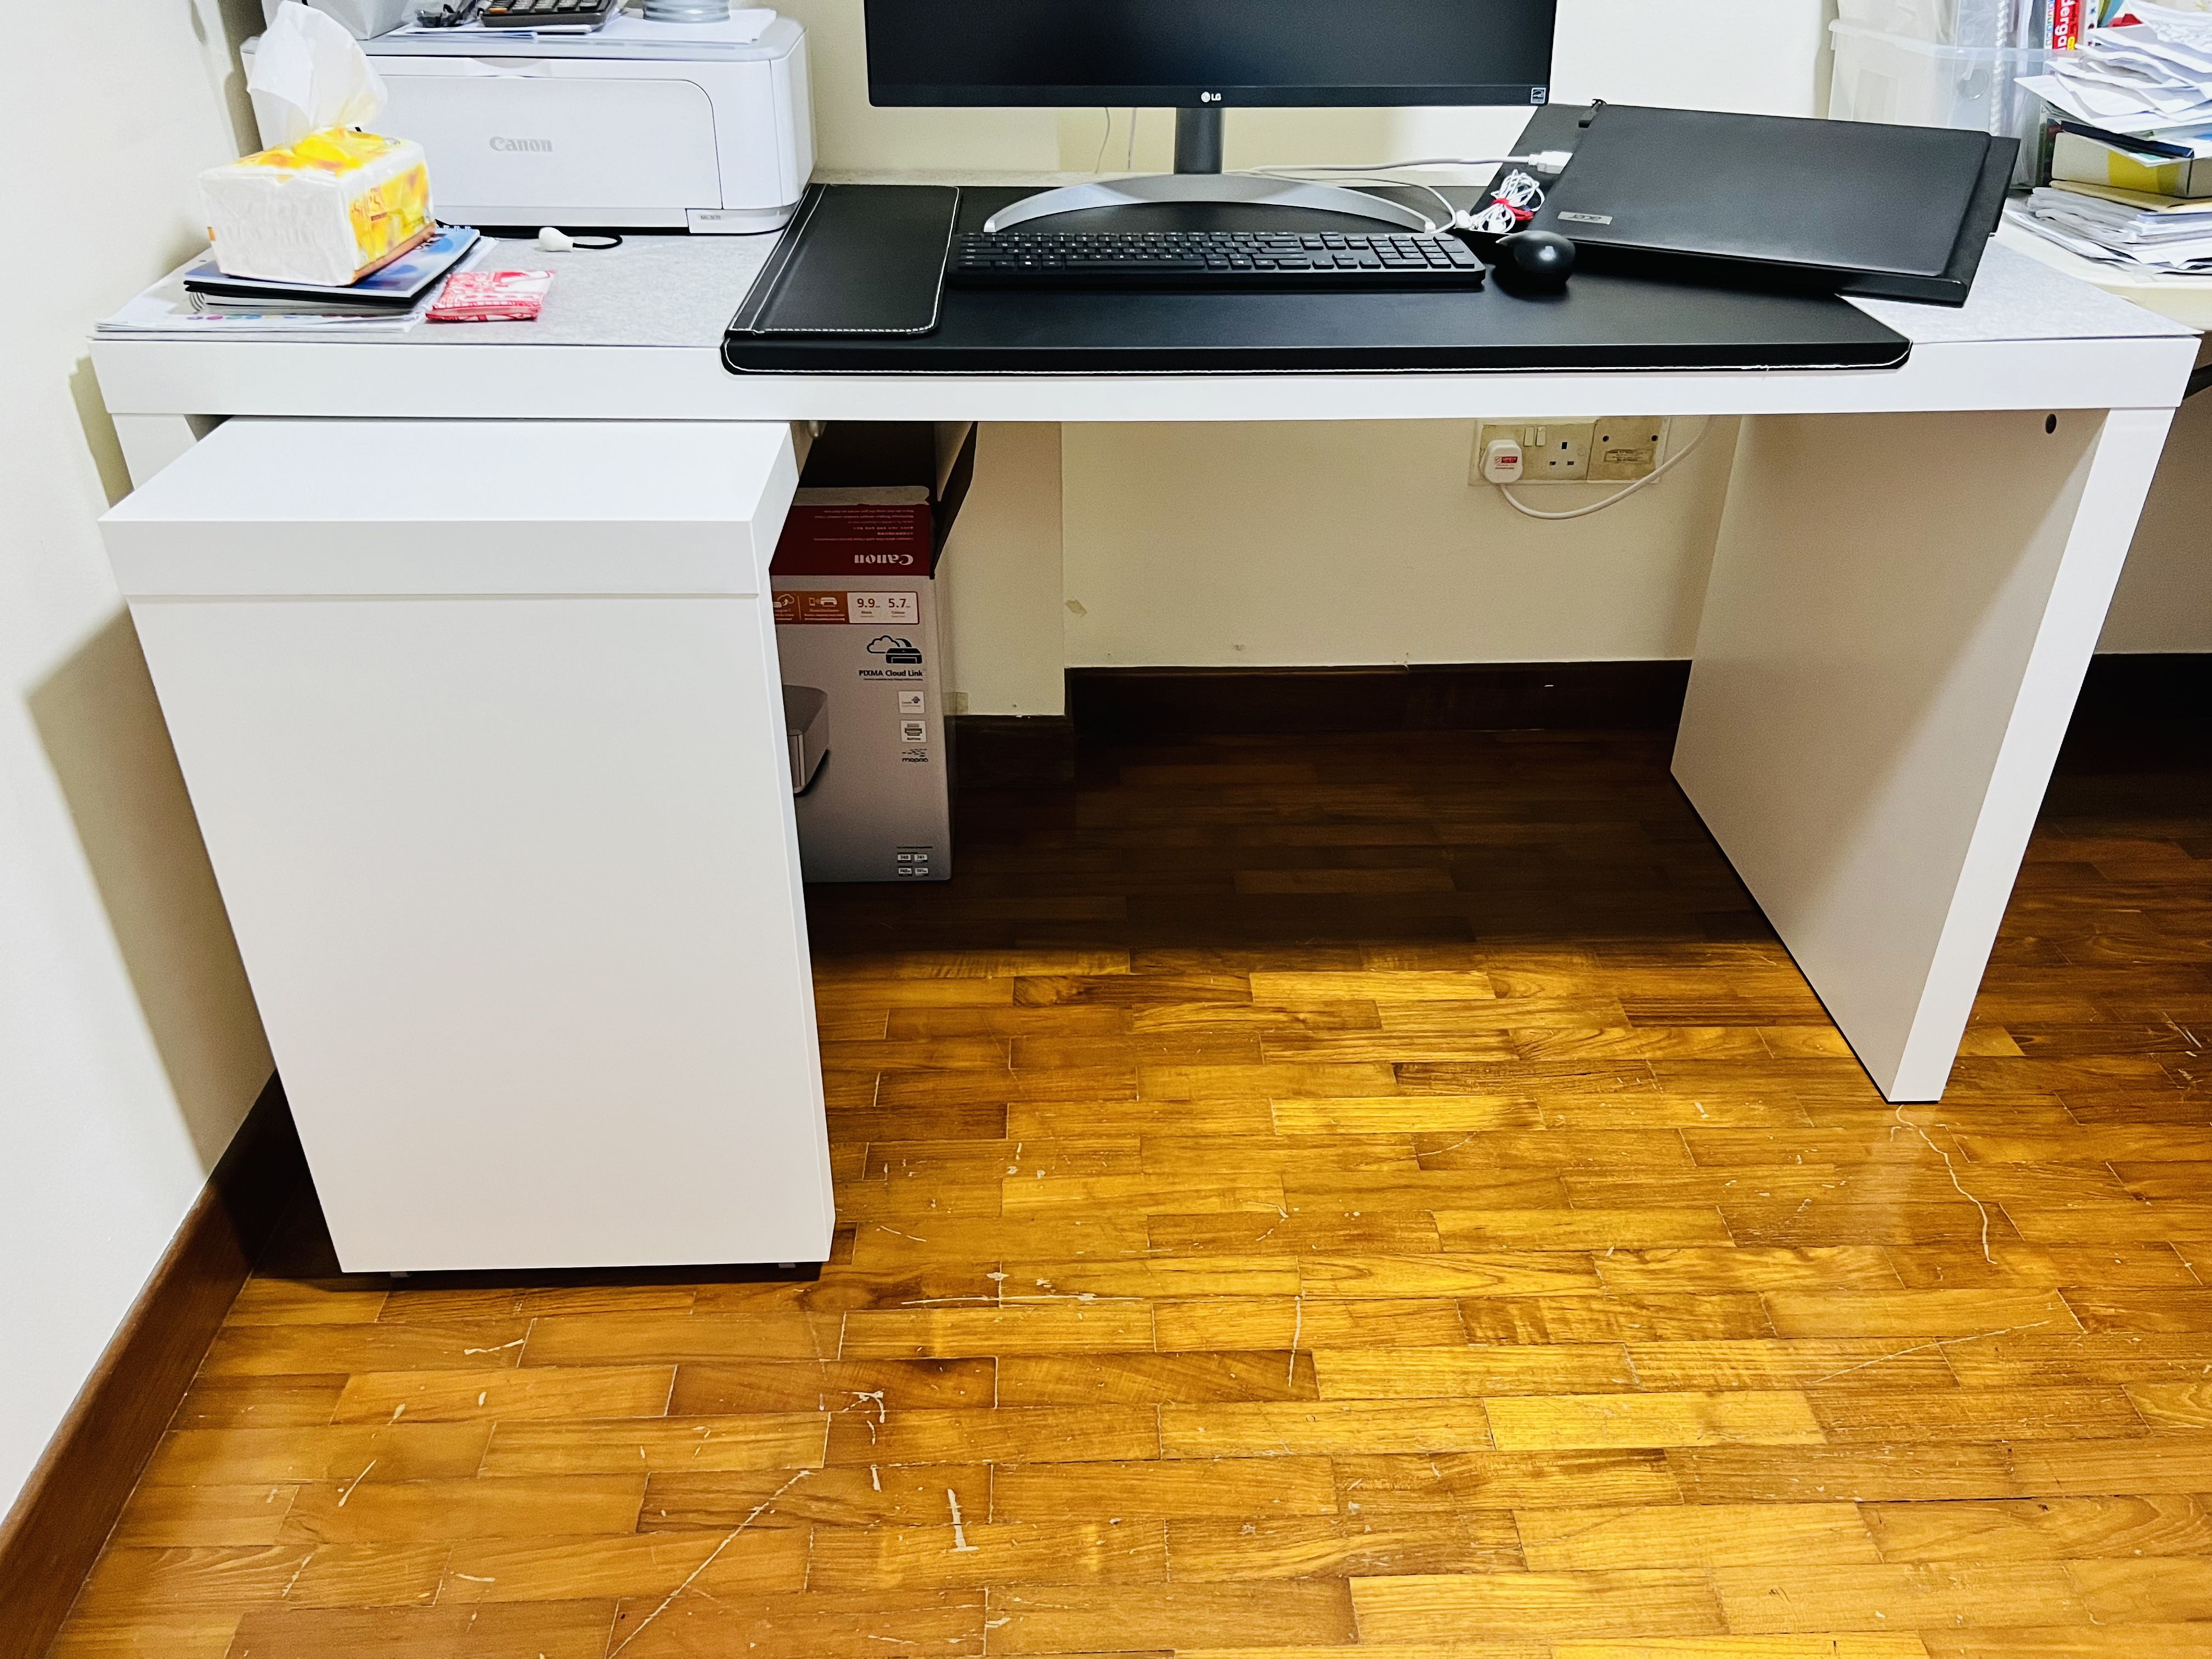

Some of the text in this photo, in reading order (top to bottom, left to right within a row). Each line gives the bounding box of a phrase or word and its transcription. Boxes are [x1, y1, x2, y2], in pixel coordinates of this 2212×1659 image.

[489, 136, 553, 153] Canon
[854, 554, 913, 566] Canon
[857, 598, 906, 608] 9.9 5.7
